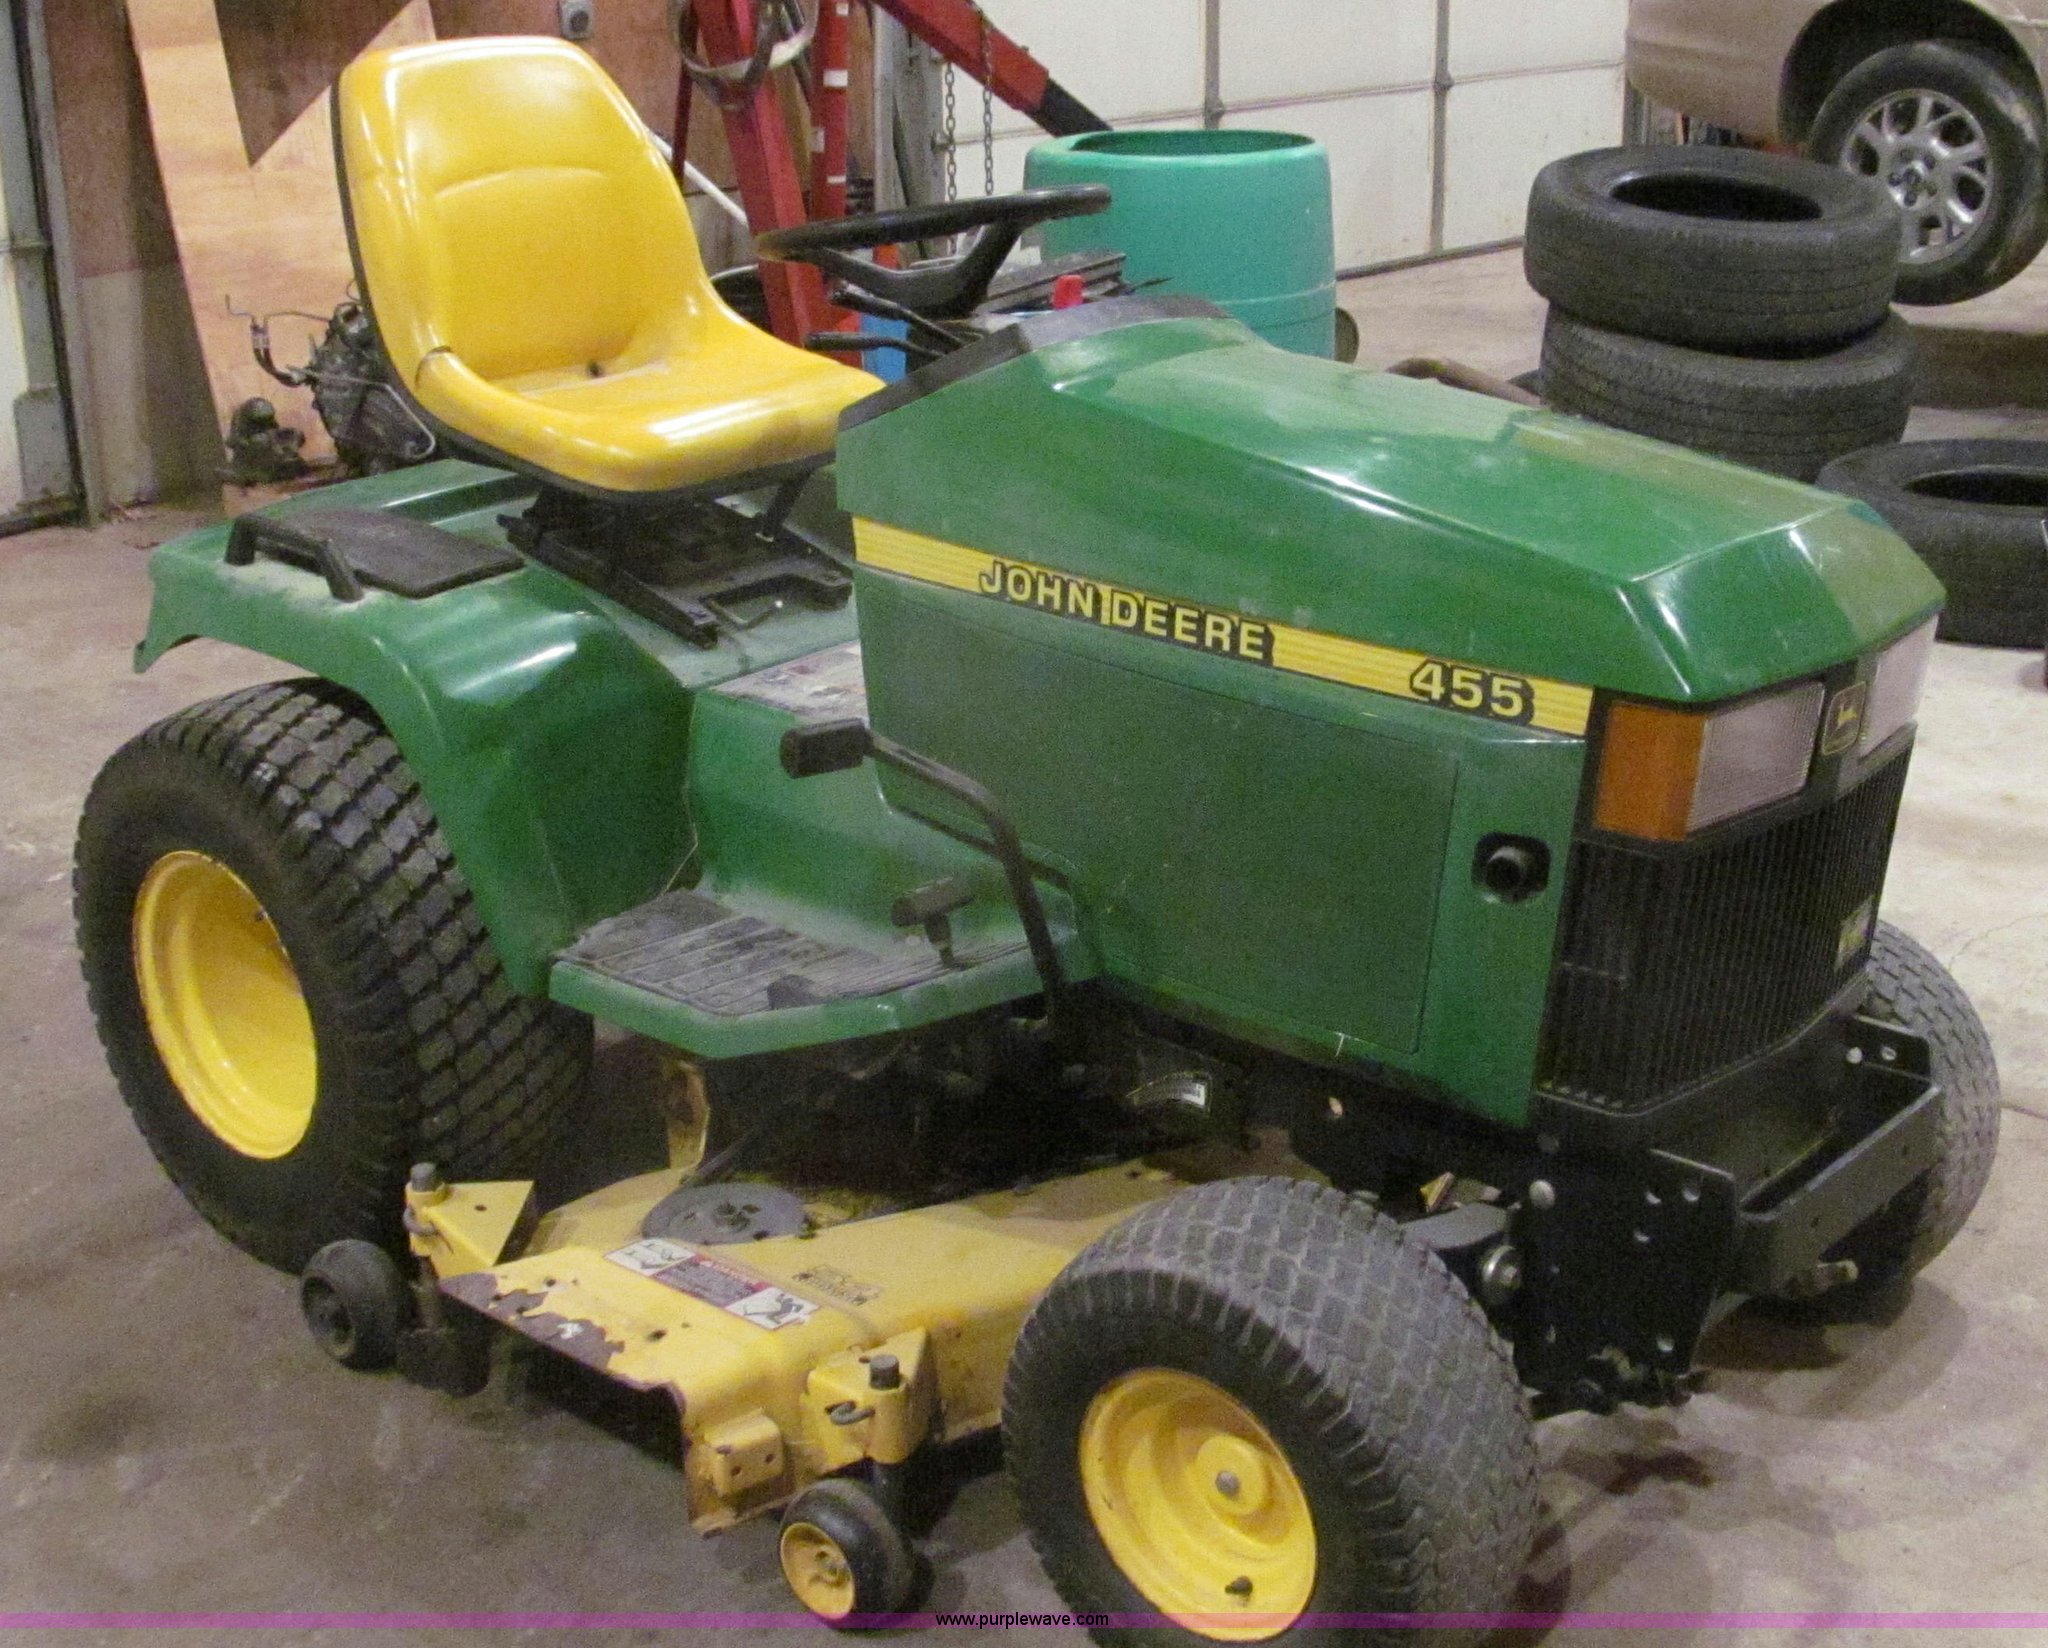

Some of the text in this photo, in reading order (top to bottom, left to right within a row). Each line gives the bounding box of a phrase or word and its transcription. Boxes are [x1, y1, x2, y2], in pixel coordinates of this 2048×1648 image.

[979, 560, 1269, 661] JOHN DEERE
[1411, 660, 1527, 719] 455
